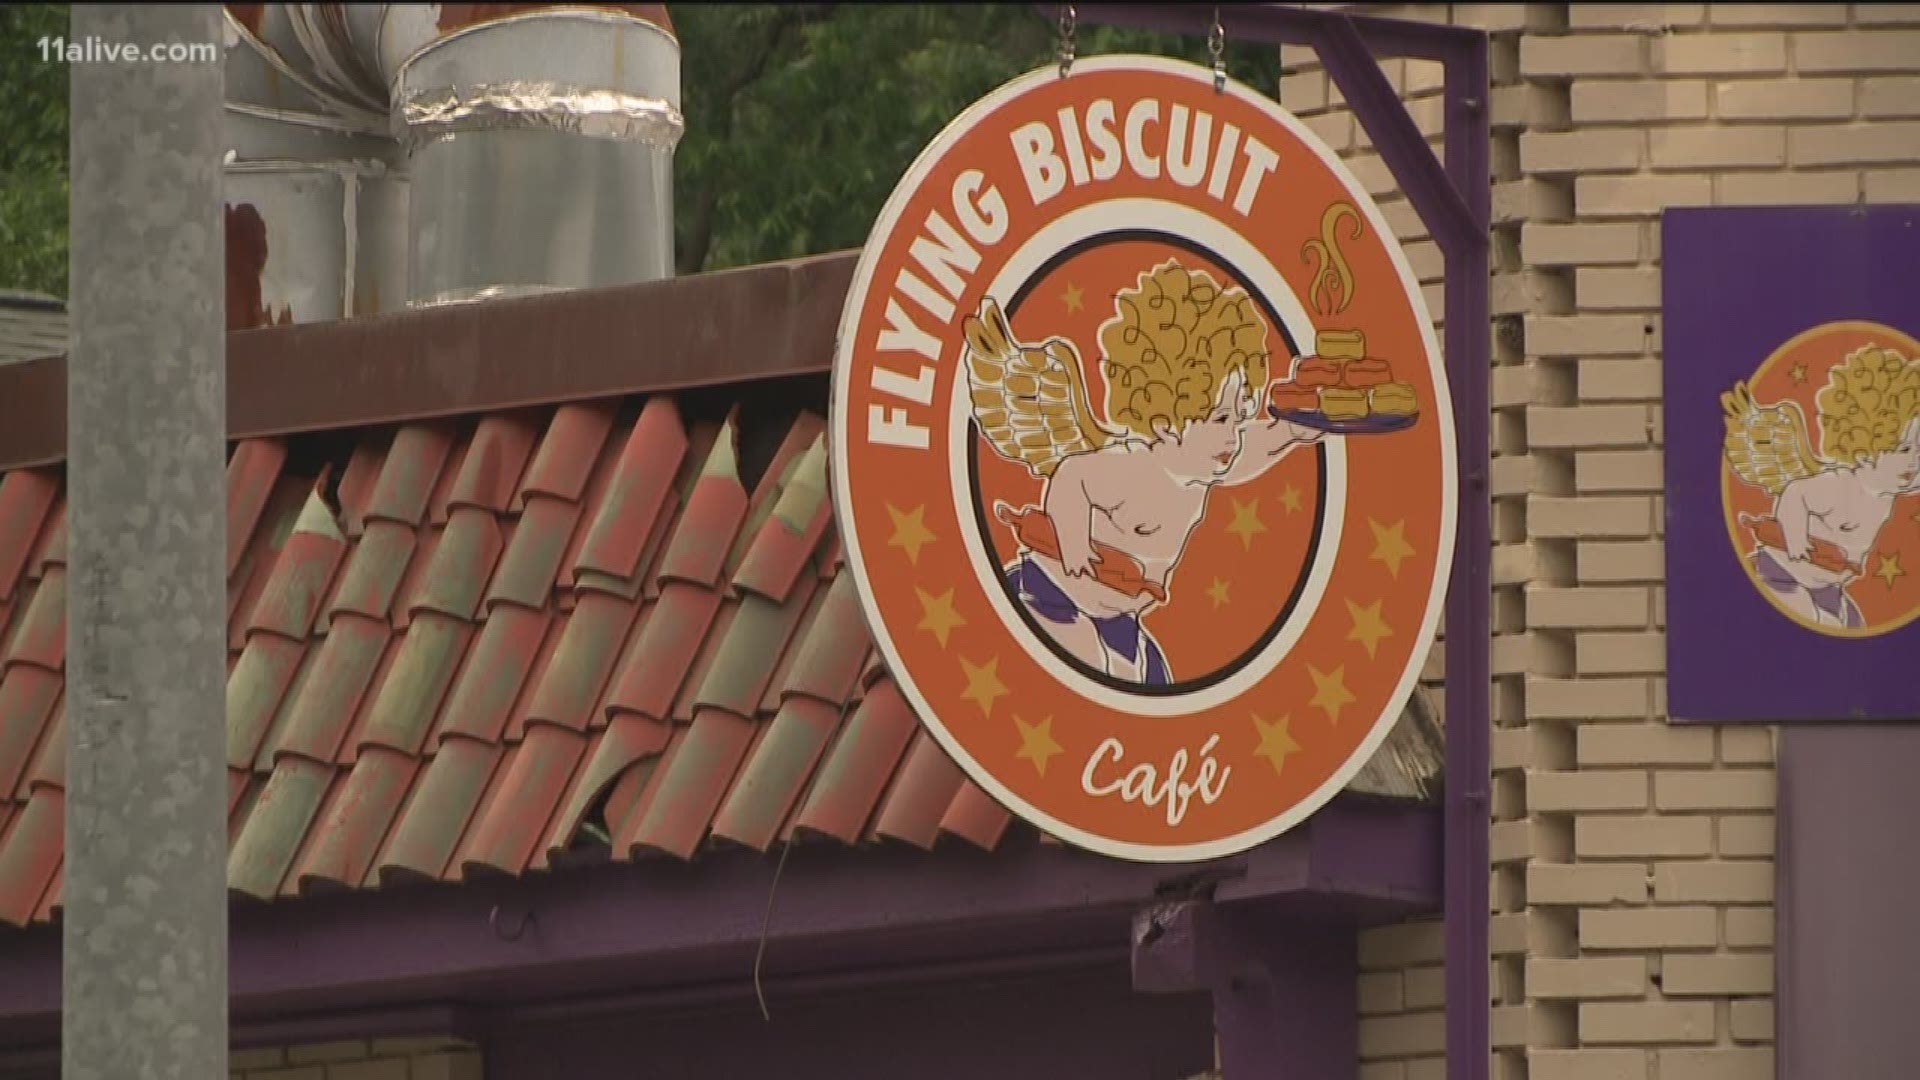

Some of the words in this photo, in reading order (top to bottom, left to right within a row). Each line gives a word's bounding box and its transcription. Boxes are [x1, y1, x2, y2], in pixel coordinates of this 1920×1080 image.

[867, 168, 1010, 450] FLYING
[1010, 98, 1280, 217] BISCUIT
[1081, 732, 1231, 826] Café
